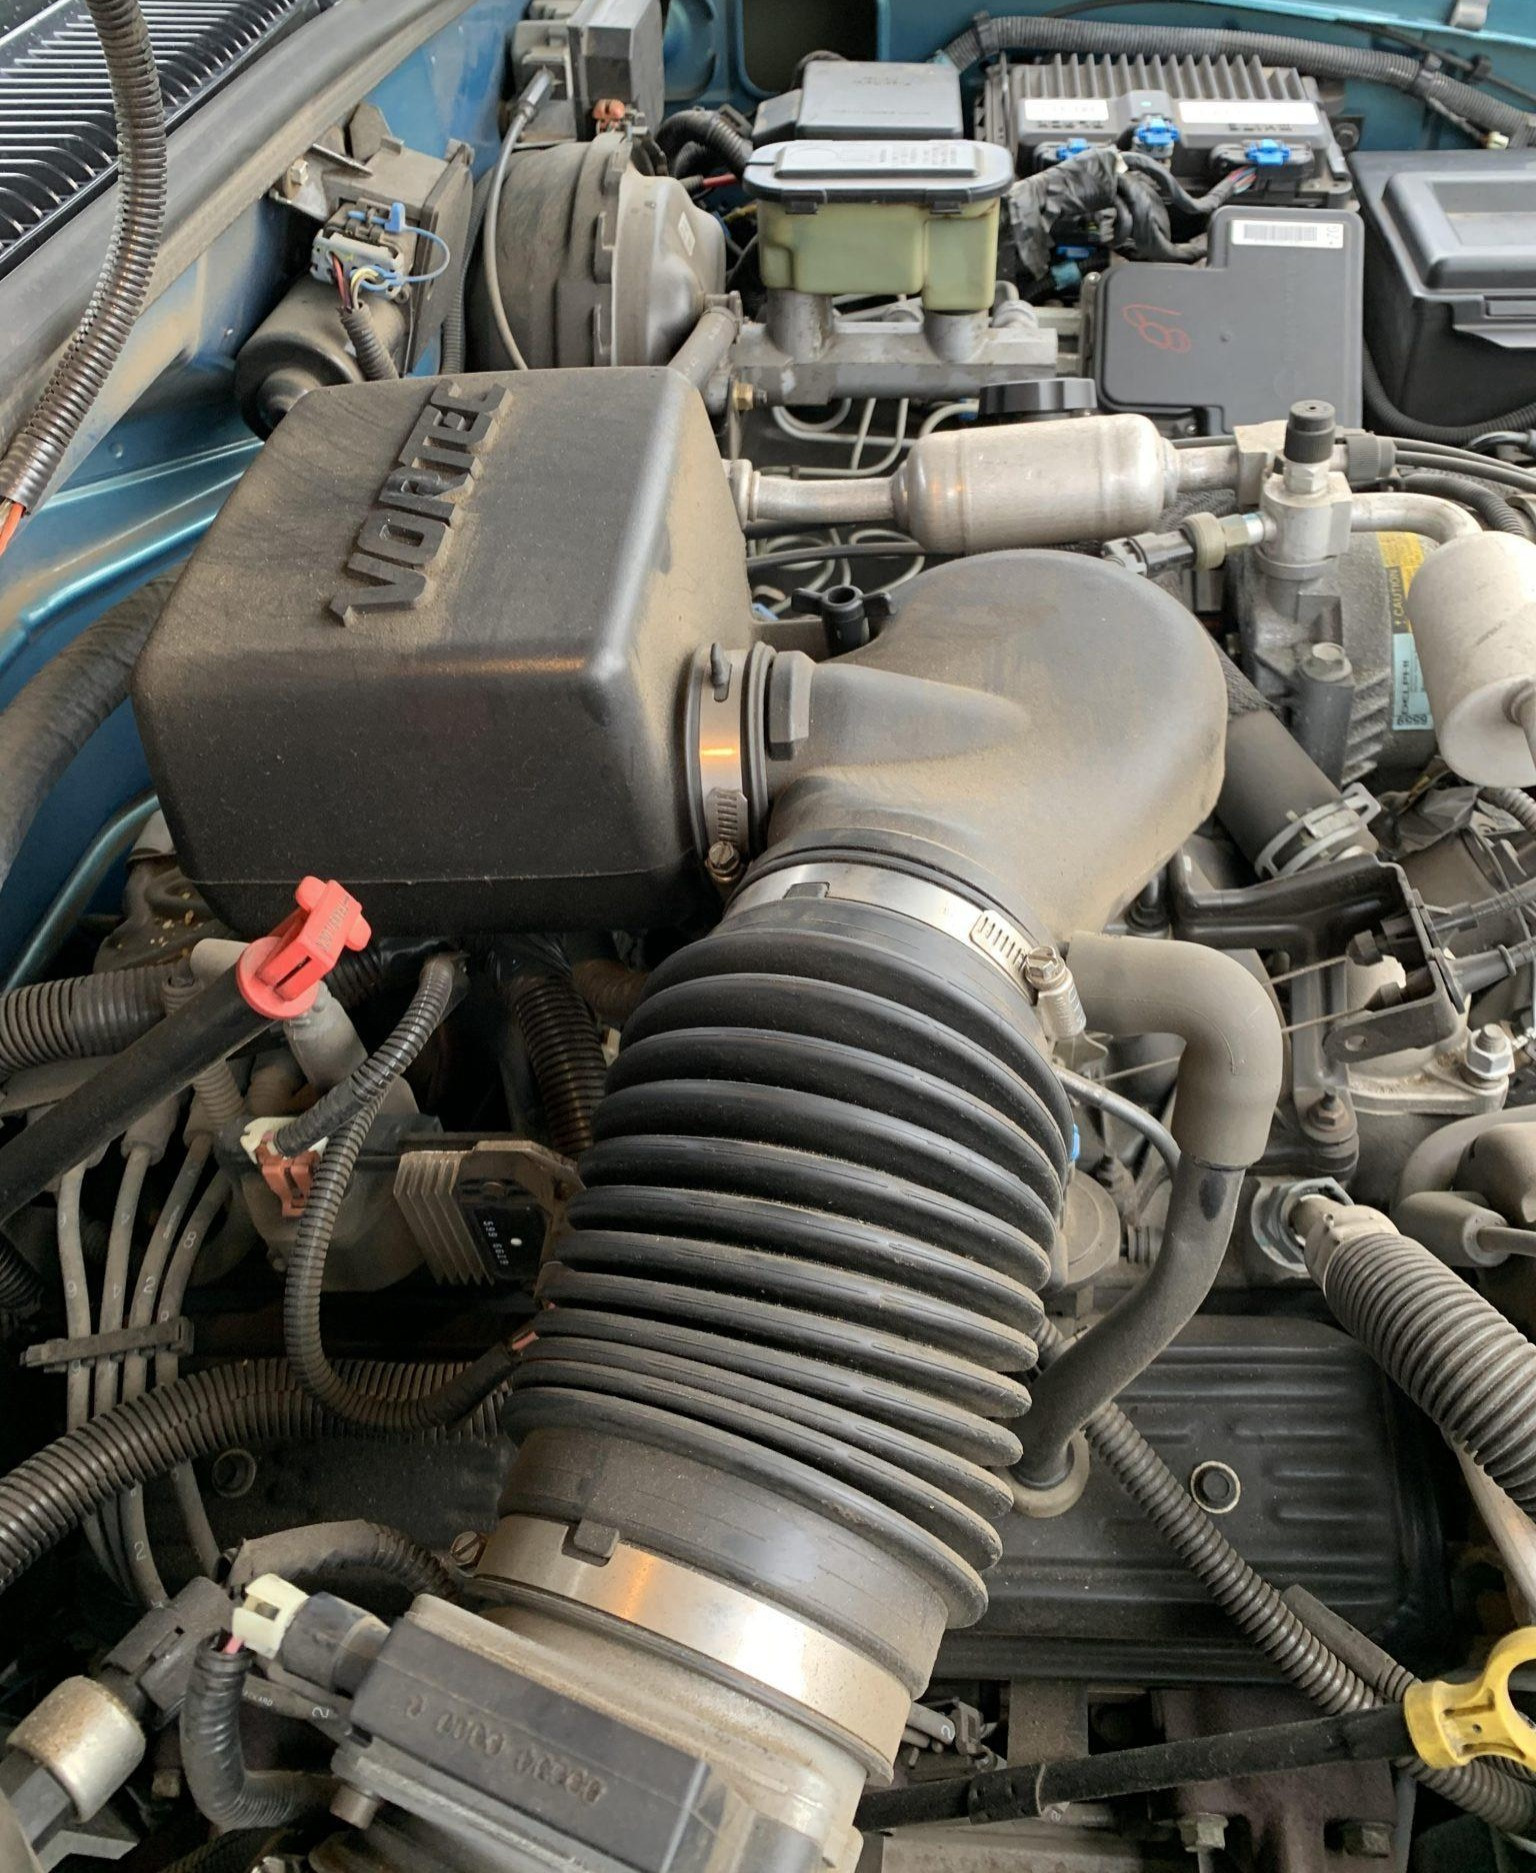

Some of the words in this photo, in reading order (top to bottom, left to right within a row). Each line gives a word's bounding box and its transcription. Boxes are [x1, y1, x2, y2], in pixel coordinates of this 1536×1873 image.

[328, 379, 510, 624] VORTEC
[1390, 568, 1405, 617] CAUTION
[183, 1231, 197, 1249] 8
[143, 1275, 156, 1294] 2
[134, 1540, 147, 1561] 2
[311, 1706, 330, 1719] 2
